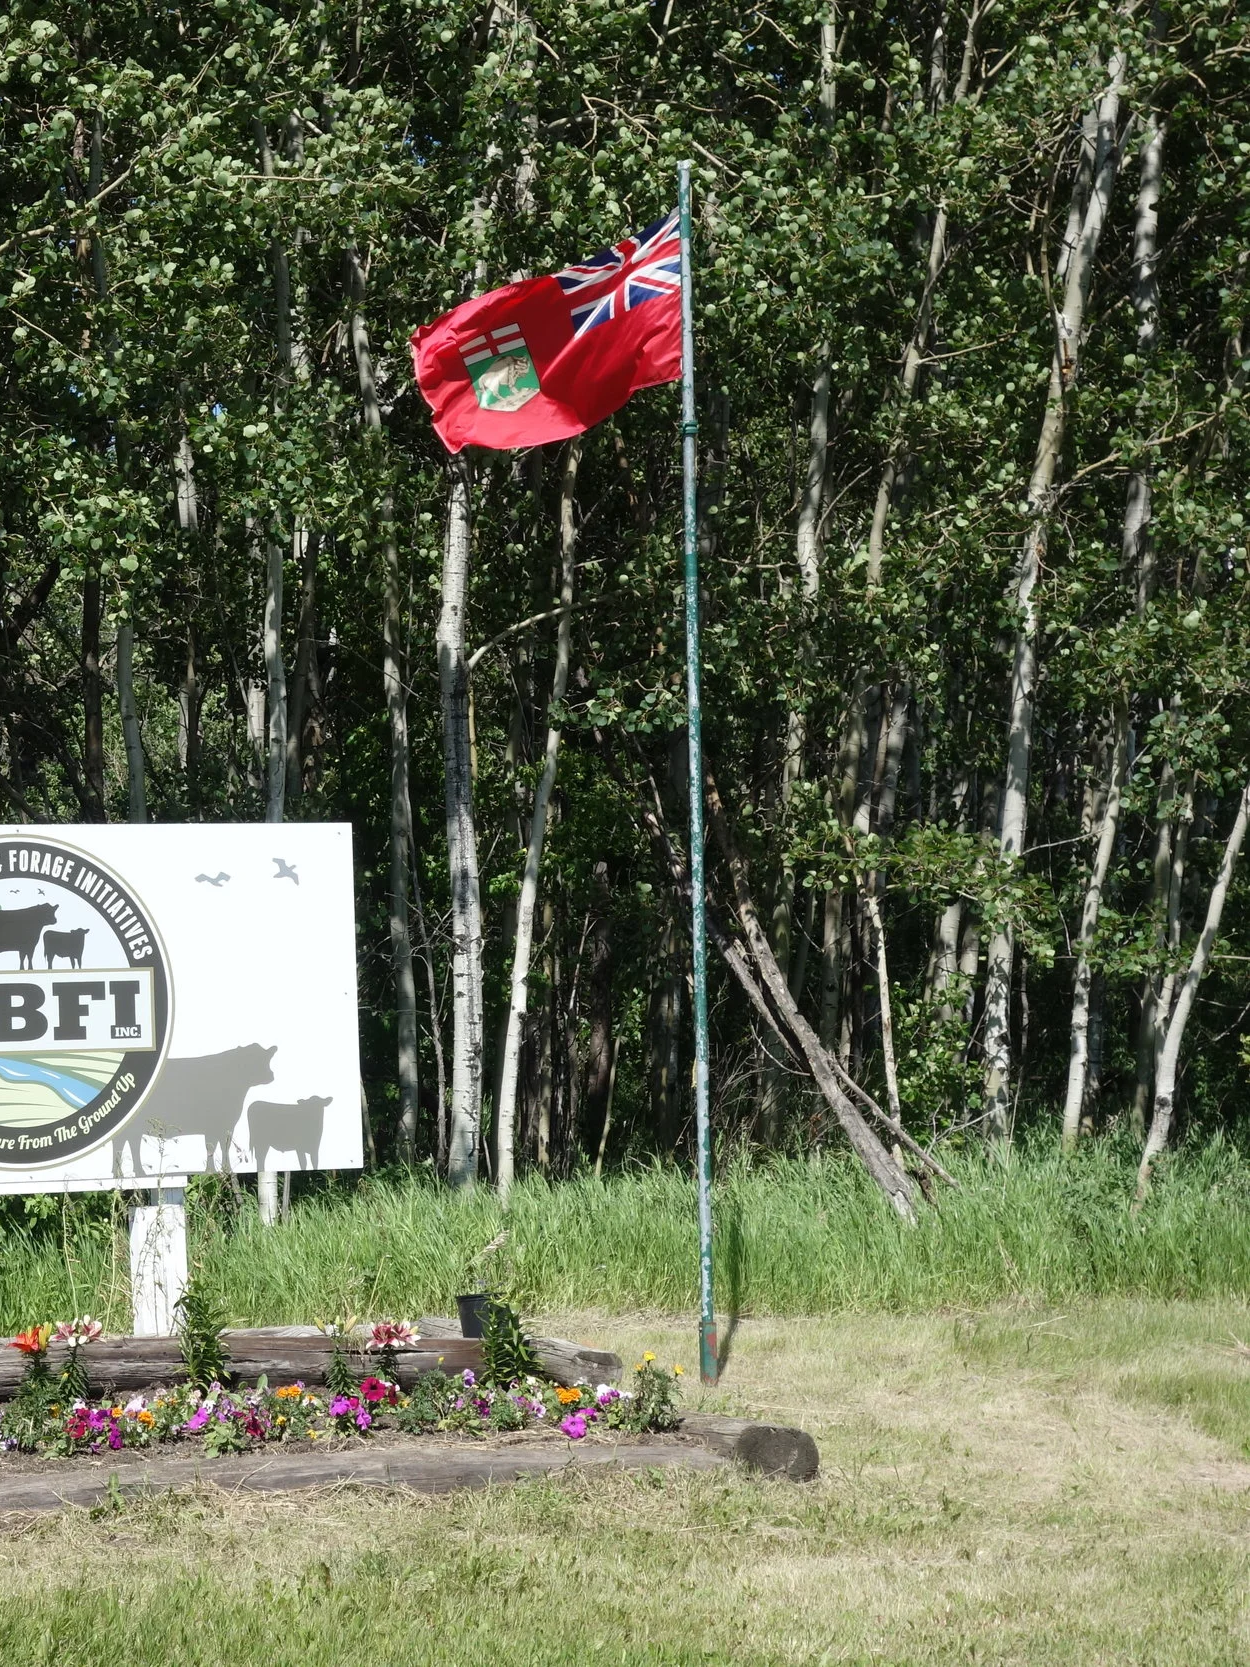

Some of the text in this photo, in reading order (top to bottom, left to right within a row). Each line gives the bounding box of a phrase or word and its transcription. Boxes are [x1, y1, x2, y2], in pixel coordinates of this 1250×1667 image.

[8, 849, 76, 882] FORAGE
[74, 866, 153, 960] INITIATIVES
[114, 1026, 142, 1038] INC.
[17, 1134, 54, 1150] From
[53, 1125, 78, 1143] The
[78, 1089, 122, 1135] Ground
[115, 1072, 136, 1092] Up
